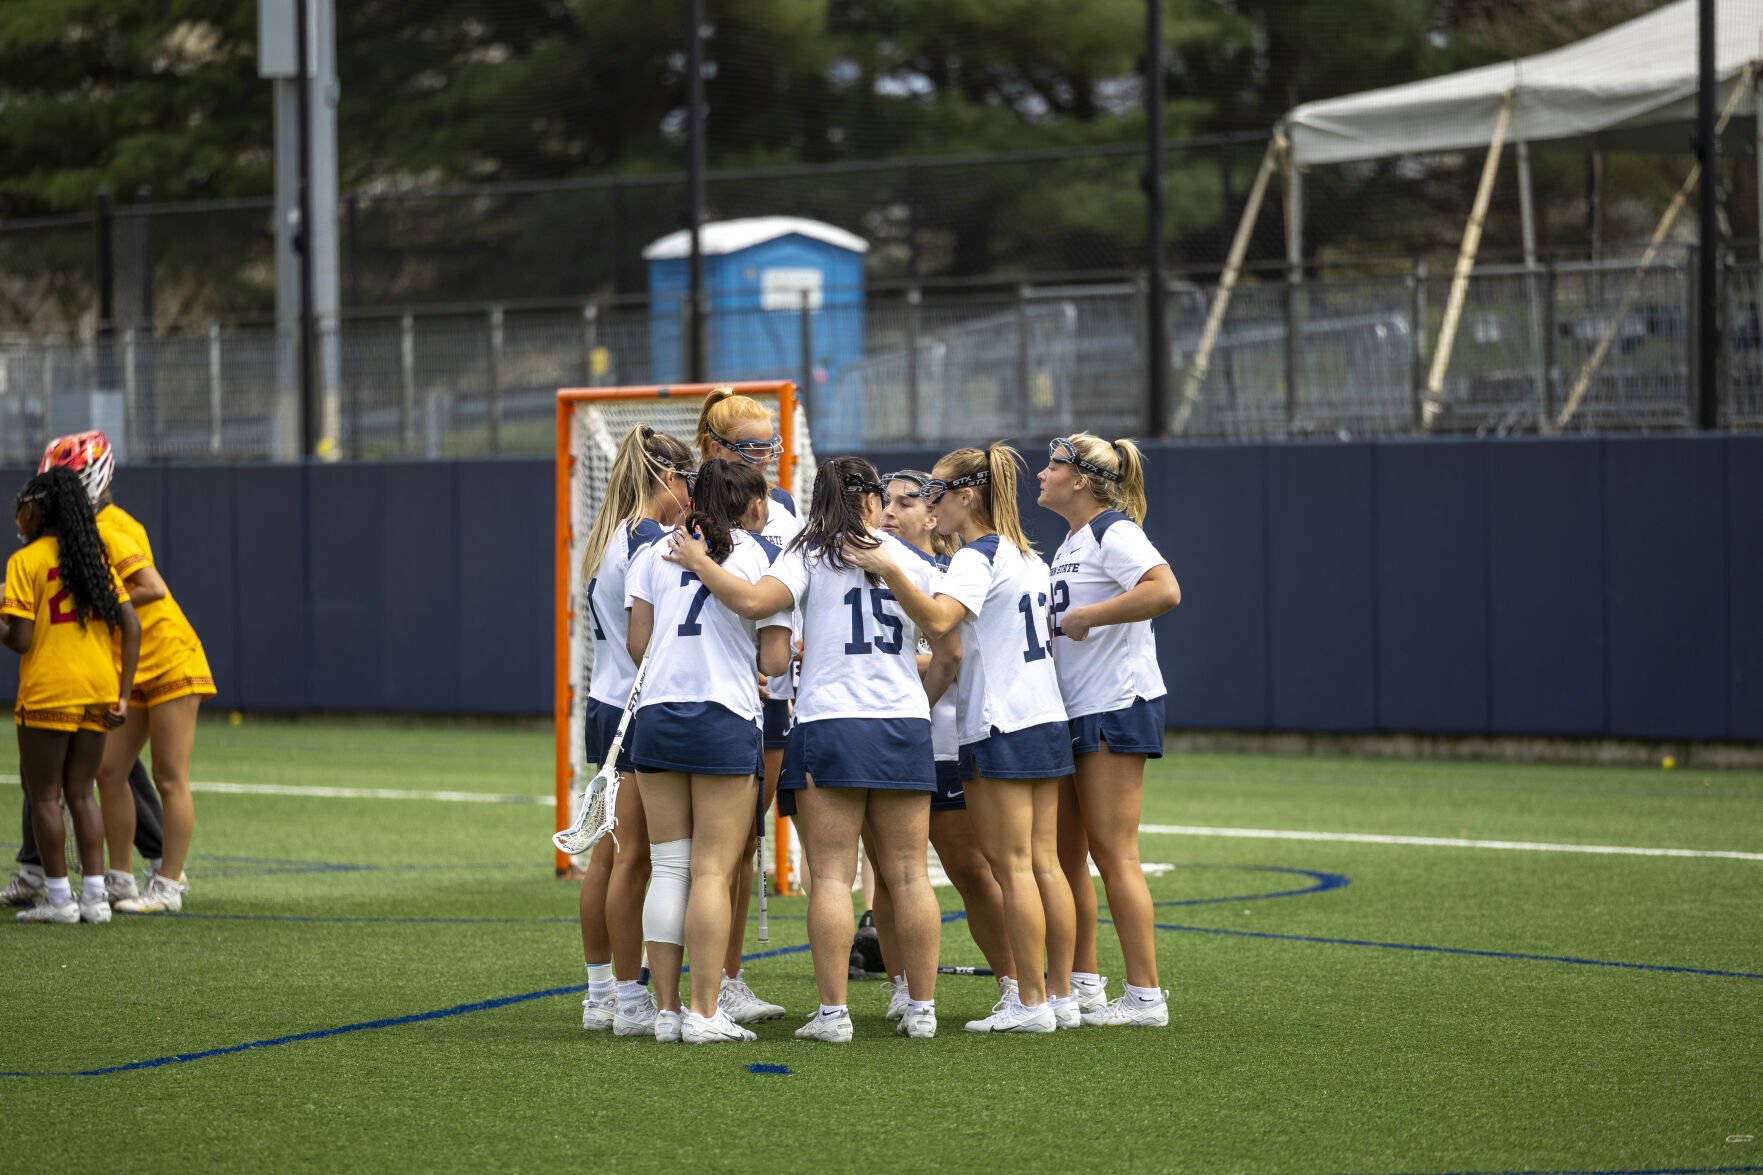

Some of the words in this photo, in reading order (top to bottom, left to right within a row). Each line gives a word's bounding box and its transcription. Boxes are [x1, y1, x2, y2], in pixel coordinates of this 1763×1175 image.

[952, 475, 971, 486] STX
[977, 470, 990, 479] ST
[677, 570, 712, 637] 7
[844, 587, 904, 656] 15
